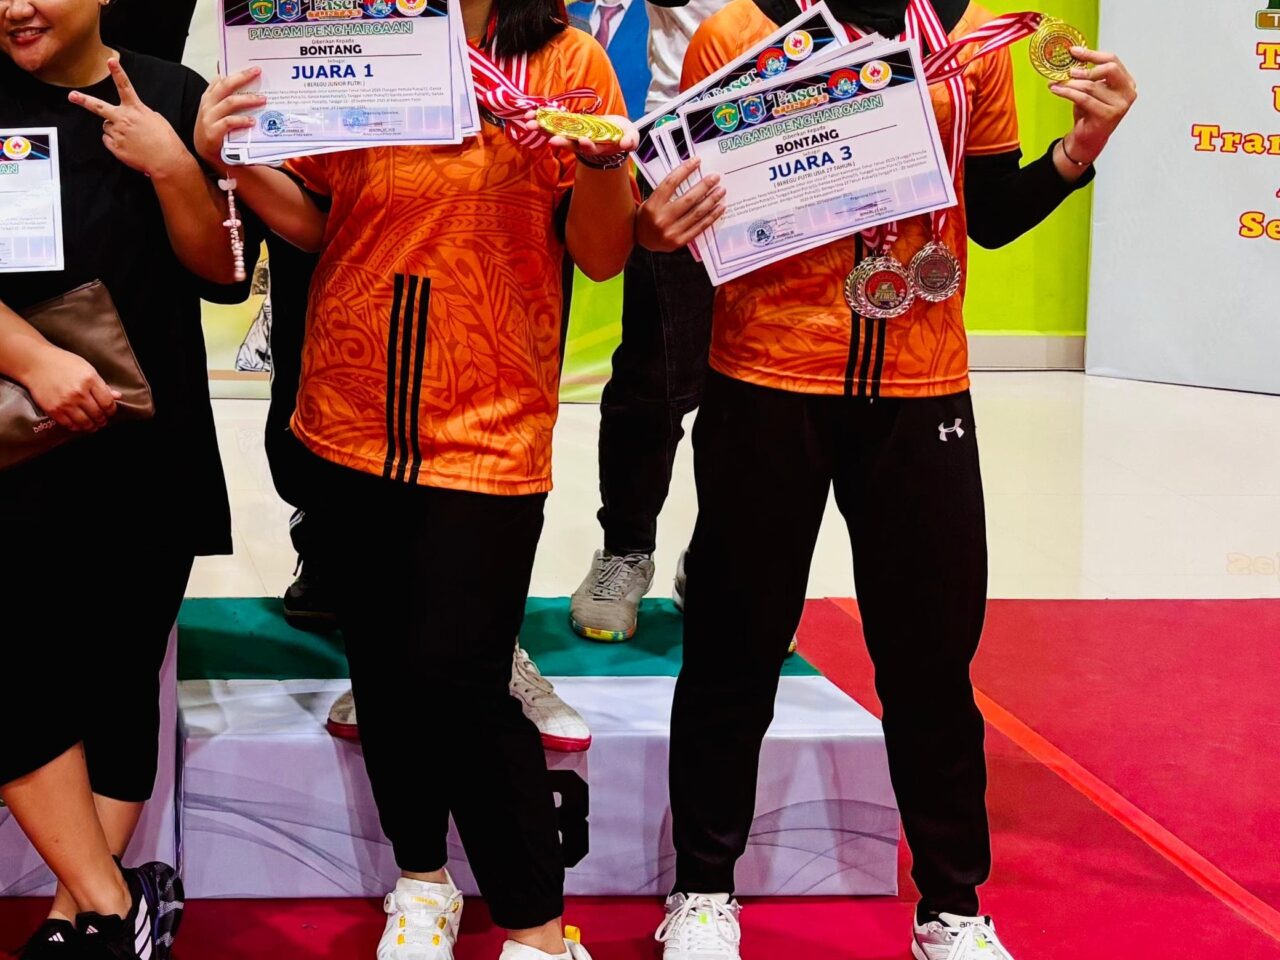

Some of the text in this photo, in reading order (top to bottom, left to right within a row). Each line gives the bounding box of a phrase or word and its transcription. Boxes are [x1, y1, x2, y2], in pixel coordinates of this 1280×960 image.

[310, 10, 361, 19] TUNTAS
[248, 21, 413, 40] PIAGAM PENGHARGAAN
[300, 44, 362, 56] BONTANG
[291, 64, 374, 79] JUARA 1
[767, 83, 828, 107] Paser
[718, 94, 883, 153] PIAGAM PENGHARGAAN
[776, 129, 839, 155] BONTANG
[769, 146, 852, 181] JUARA 3
